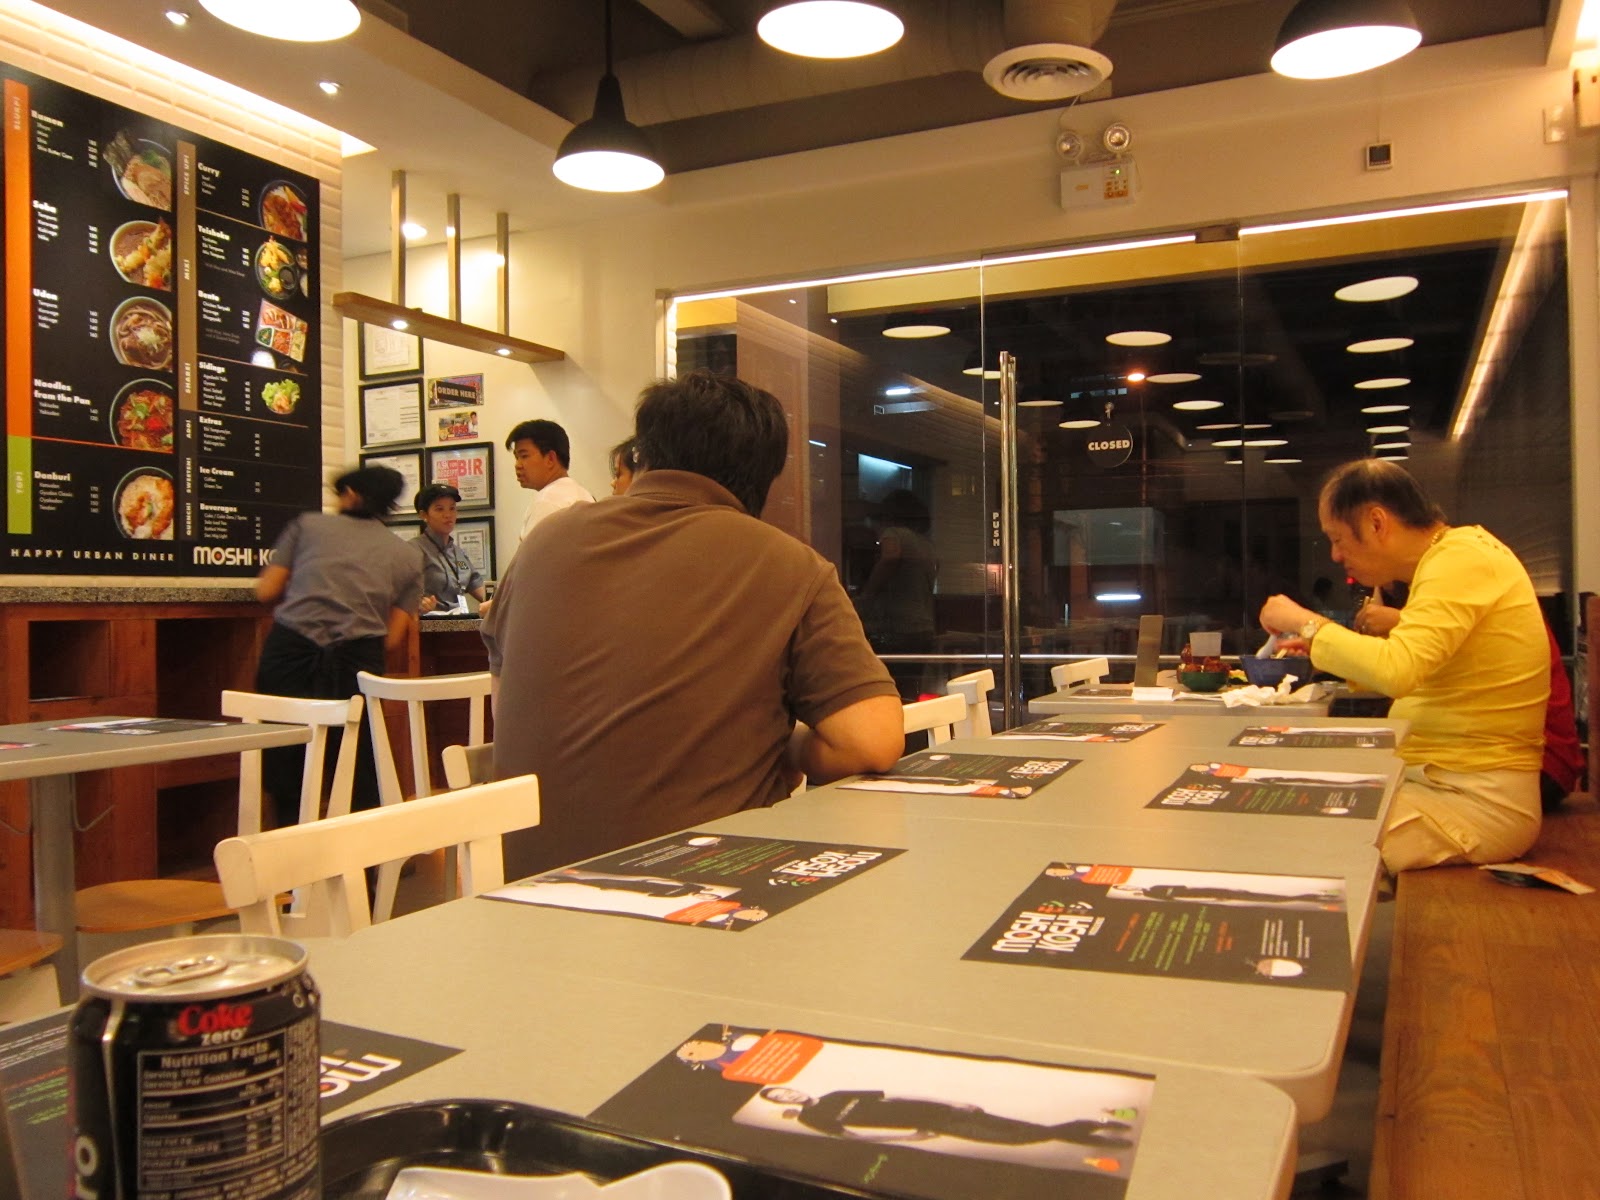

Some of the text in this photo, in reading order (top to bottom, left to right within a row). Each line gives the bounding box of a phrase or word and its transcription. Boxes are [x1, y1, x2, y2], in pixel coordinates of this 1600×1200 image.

[31, 109, 64, 128] Ramen
[197, 161, 221, 178] Curry
[32, 287, 59, 301] Udon
[198, 361, 226, 375] Sidings
[34, 378, 72, 392] Noodles
[437, 386, 476, 399] ORDER HERE
[34, 389, 92, 406] from the Pan
[198, 415, 223, 427] Extras
[1088, 439, 1131, 451] CLOSED
[199, 466, 235, 477] Ice Cream
[458, 458, 483, 476] BIR
[34, 470, 71, 482] Donburi
[199, 502, 238, 514] Beverages
[992, 512, 1000, 547] PUSH
[11, 548, 175, 562] HAPPY URBAN DINER
[781, 850, 851, 876] KOSHI
[809, 851, 883, 878] MOSHI
[991, 911, 1056, 954] MOSHI
[1037, 913, 1094, 953] KOSHI
[177, 1003, 254, 1037] Coke
[200, 1027, 244, 1046] zero
[161, 1041, 270, 1068] Nutrition Facts
[185, 1077, 202, 1088] Per
[204, 1069, 247, 1084] Container
